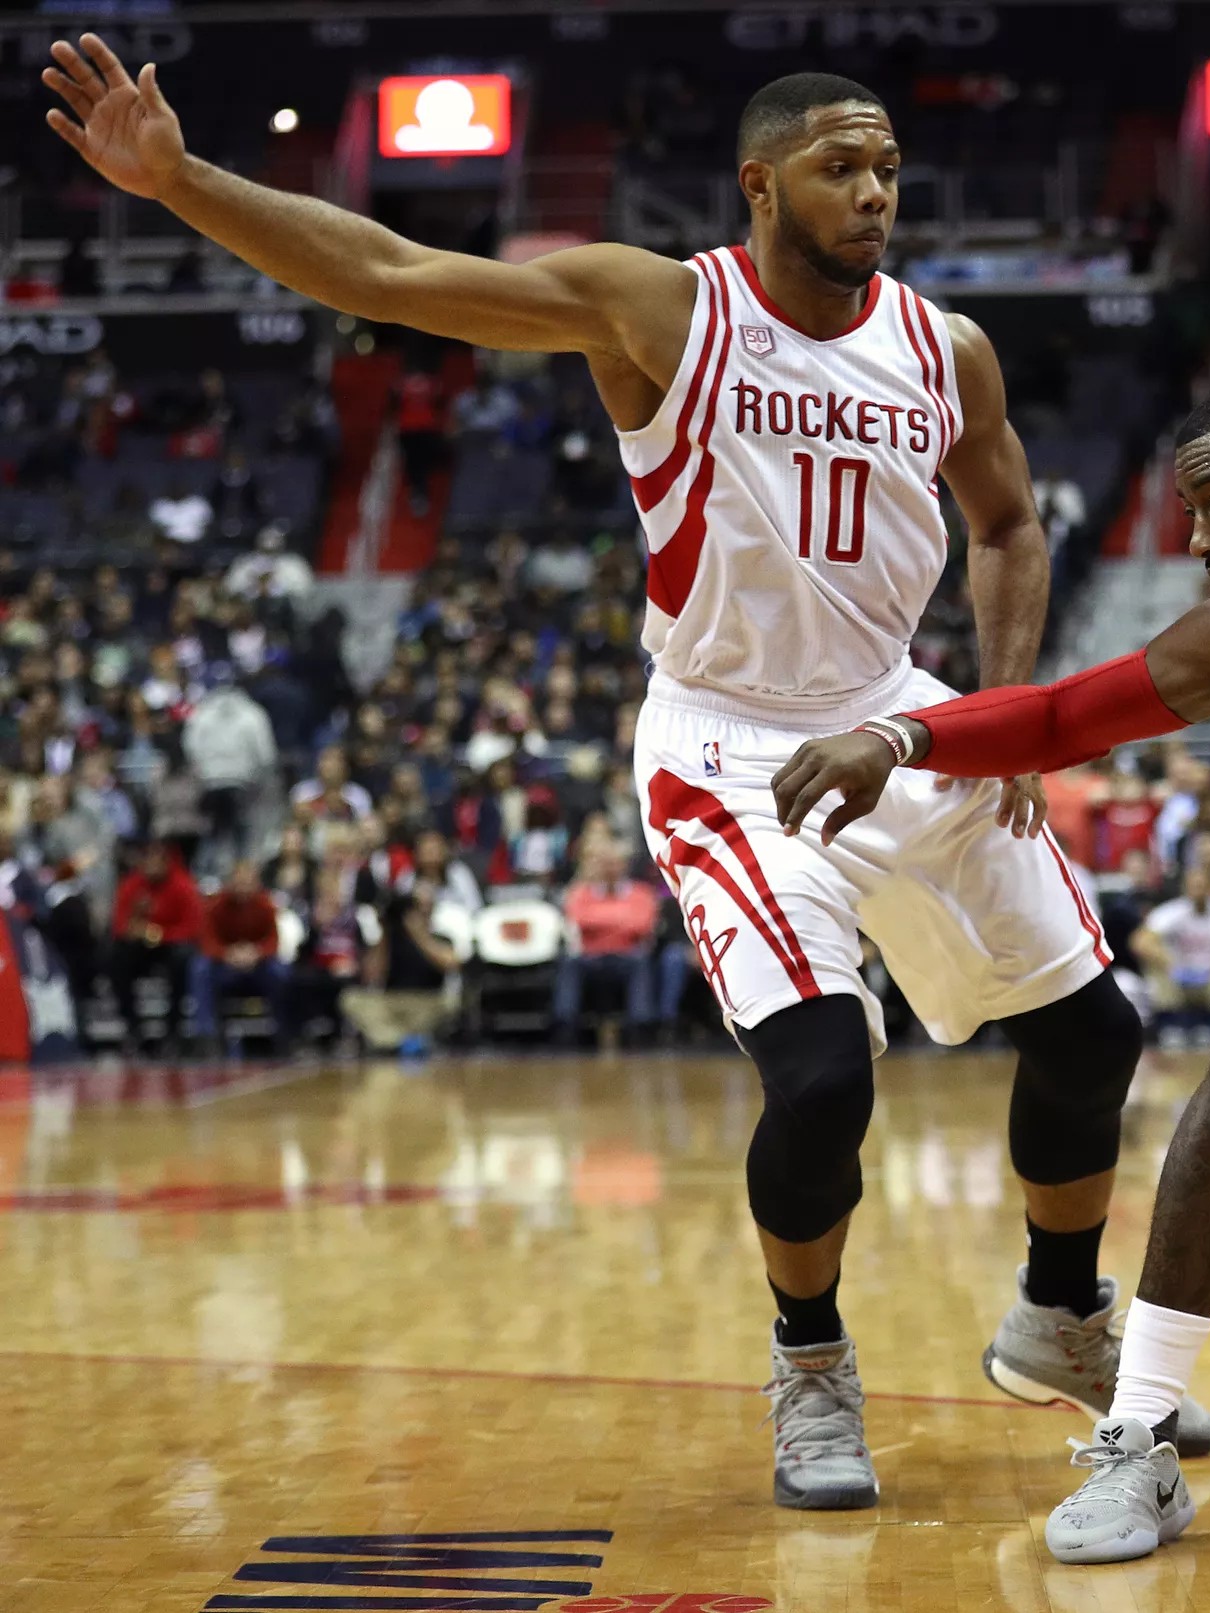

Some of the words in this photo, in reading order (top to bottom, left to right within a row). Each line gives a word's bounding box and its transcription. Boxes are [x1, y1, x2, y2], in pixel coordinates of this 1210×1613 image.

[745, 329, 768, 343] 50
[730, 377, 930, 453] ROCKETS
[793, 452, 871, 566] 10
